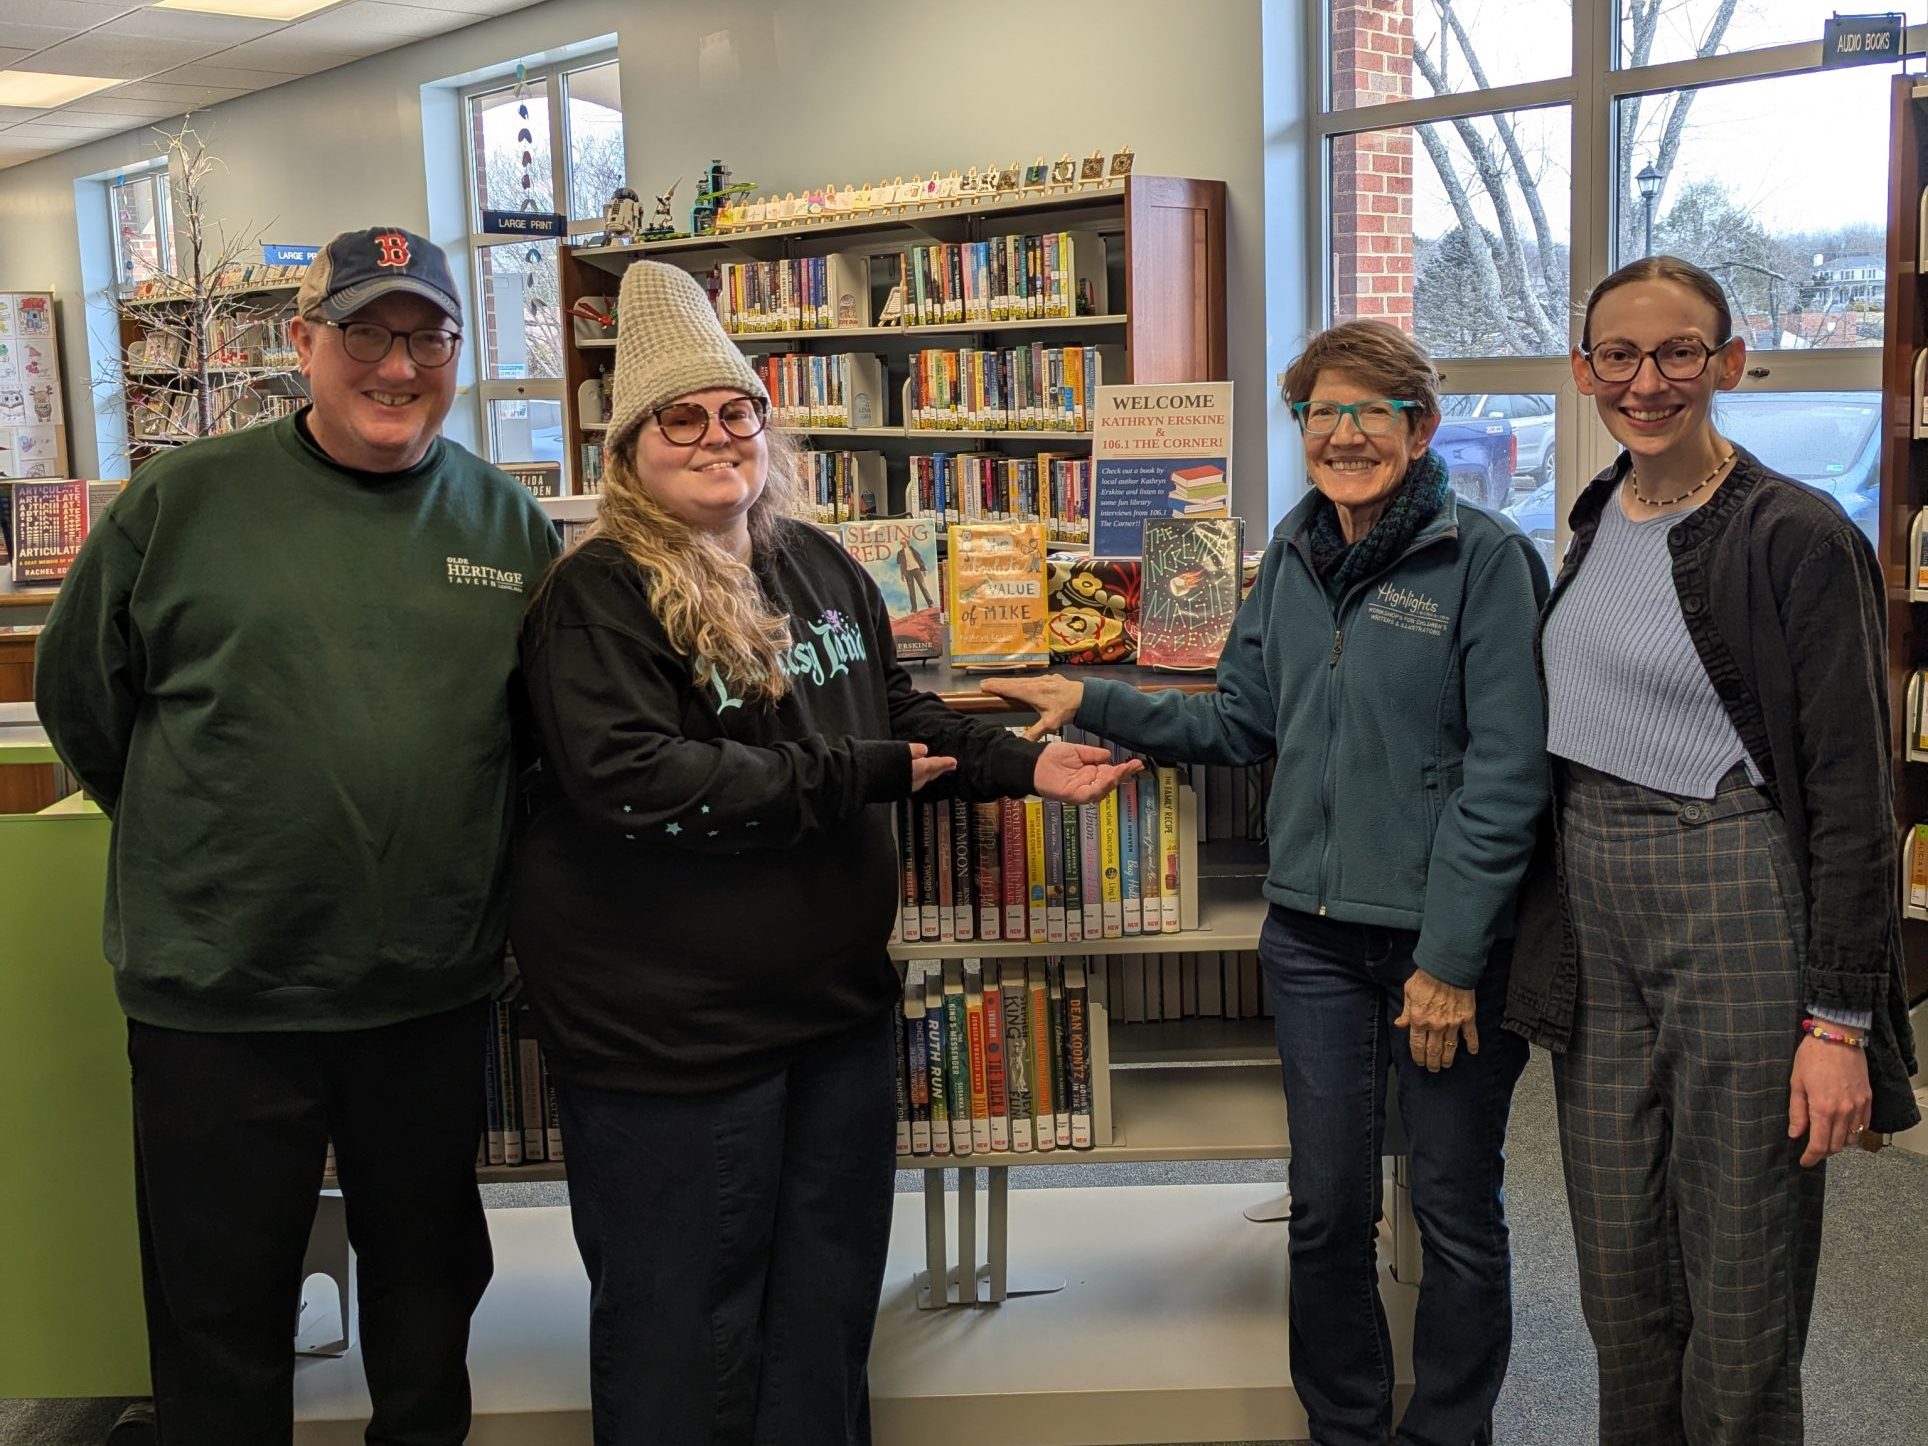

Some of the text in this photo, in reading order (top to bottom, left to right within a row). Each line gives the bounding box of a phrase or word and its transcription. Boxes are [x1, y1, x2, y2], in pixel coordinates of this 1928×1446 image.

[1837, 32, 1890, 52] AUDIO BOOKS
[498, 218, 553, 230] LARGE PRINT
[278, 251, 317, 260] LARGE PR
[373, 233, 411, 267] B
[1112, 394, 1215, 410] WELCOME
[1101, 414, 1225, 427] KATHRYN ERSKINE
[1155, 427, 1165, 437] &
[1103, 437, 1223, 449] 106.1 THE CORNER!
[1101, 467, 1121, 475] Check
[1156, 467, 1164, 476] by
[1101, 477, 1166, 486] local author Kathryn
[1101, 488, 1124, 496] Erskine
[1117, 499, 1129, 507] fun
[1129, 499, 1152, 507] library
[1133, 509, 1148, 518] from
[1149, 509, 1167, 517] 106.1
[848, 524, 928, 544] SEEING
[1146, 526, 1178, 552] THE
[19, 545, 81, 558] ARTICULATE
[446, 556, 469, 565] OLDE
[848, 544, 892, 562] RED
[25, 568, 54, 576] RACHEL
[447, 564, 524, 584] HERITAGE
[448, 576, 496, 587] TAVERN
[988, 583, 1035, 596] VALUE
[1377, 581, 1439, 613] Highlights
[1142, 575, 1233, 633] MAGIC
[962, 604, 1032, 627] of MIKE
[897, 642, 934, 650] ERSKINE
[1164, 785, 1173, 810] FAMILY
[1012, 799, 1021, 839] STOLEN
[1085, 801, 1098, 839] Albion
[1164, 811, 1173, 834] RECIPE
[956, 832, 969, 877] MOON
[1106, 827, 1115, 864] Conception
[923, 864, 932, 891] SWORD
[1004, 995, 1021, 1039] KING
[916, 1021, 924, 1041] ONCE
[928, 1019, 941, 1062] RUTH
[949, 1003, 960, 1075] KING'S MESSENGER
[1070, 999, 1084, 1079] DEAN KOONTZ
[917, 1042, 926, 1064] UPON
[919, 1072, 927, 1088] TIME
[931, 1066, 943, 1099] RUN
[1072, 1082, 1078, 1091] IN
[896, 1078, 904, 1103] SANDIE
[1079, 1084, 1087, 1106] GOING
